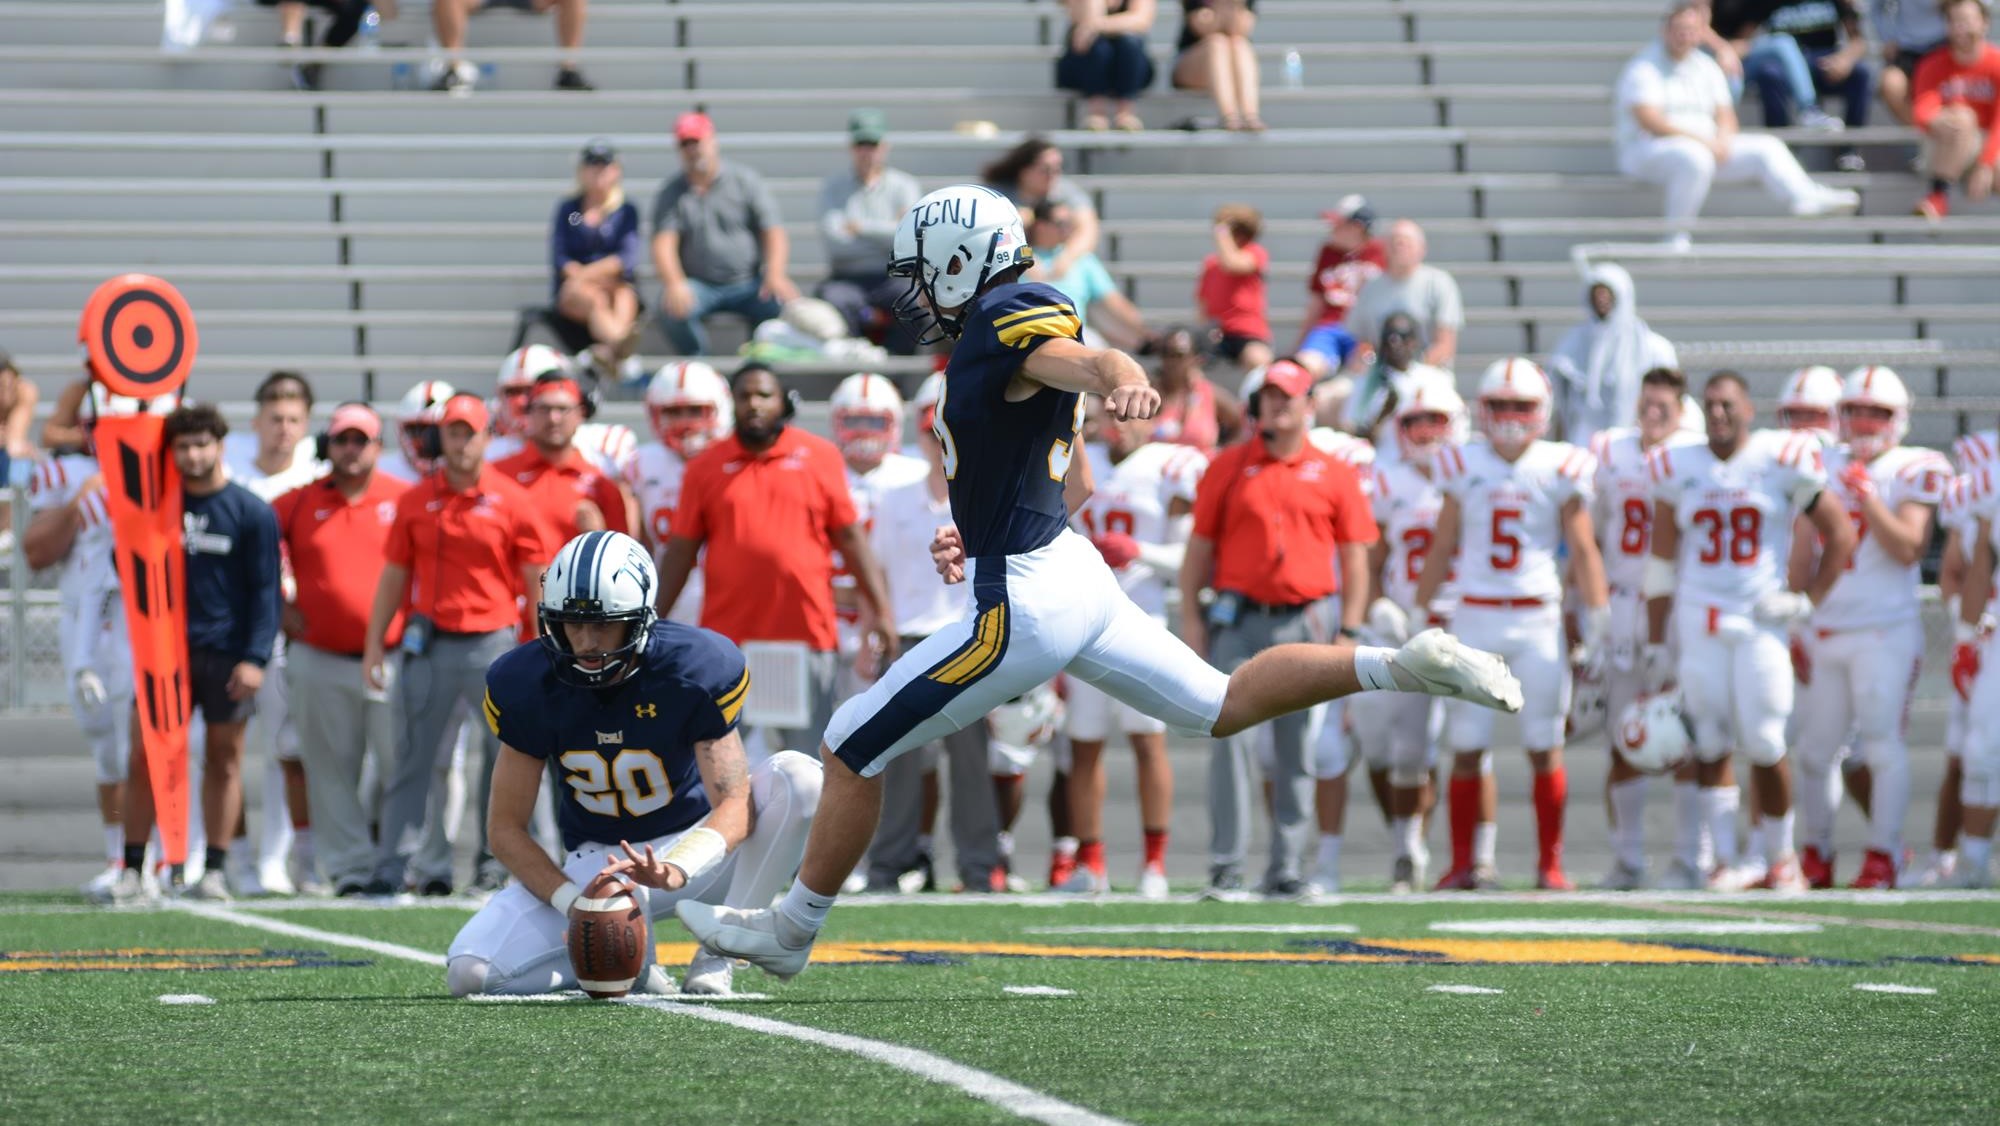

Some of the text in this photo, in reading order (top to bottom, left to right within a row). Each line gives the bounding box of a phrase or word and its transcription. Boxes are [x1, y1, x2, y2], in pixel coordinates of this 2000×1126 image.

[912, 198, 977, 233] TCNJ
[996, 251, 1010, 263] 99
[1490, 508, 1522, 570] 5
[1694, 505, 1761, 564] 38
[560, 748, 672, 817] 20
